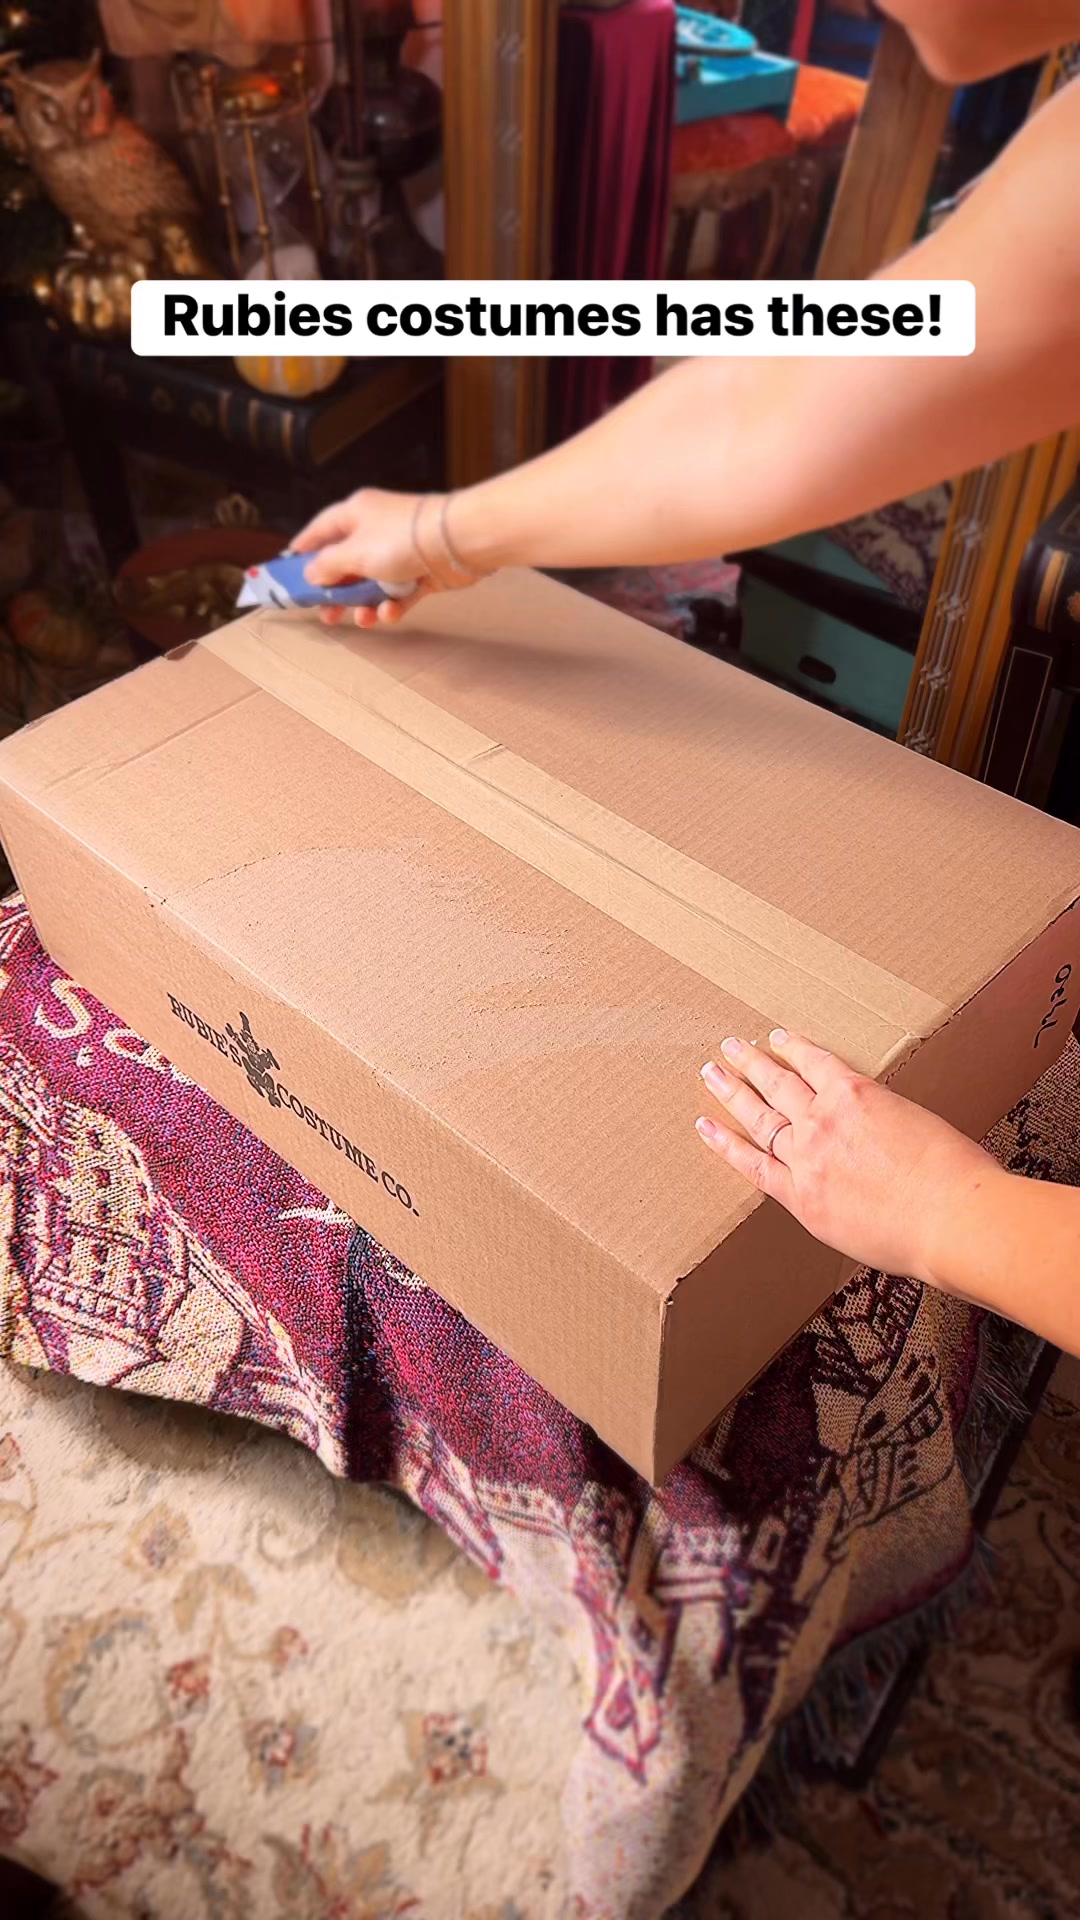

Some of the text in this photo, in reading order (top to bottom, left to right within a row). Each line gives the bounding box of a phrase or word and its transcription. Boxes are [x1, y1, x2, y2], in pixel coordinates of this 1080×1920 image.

[166, 991, 242, 1068] RUBIE'S
[276, 1083, 379, 1183] COSTUME
[381, 1171, 420, 1217] CO.
